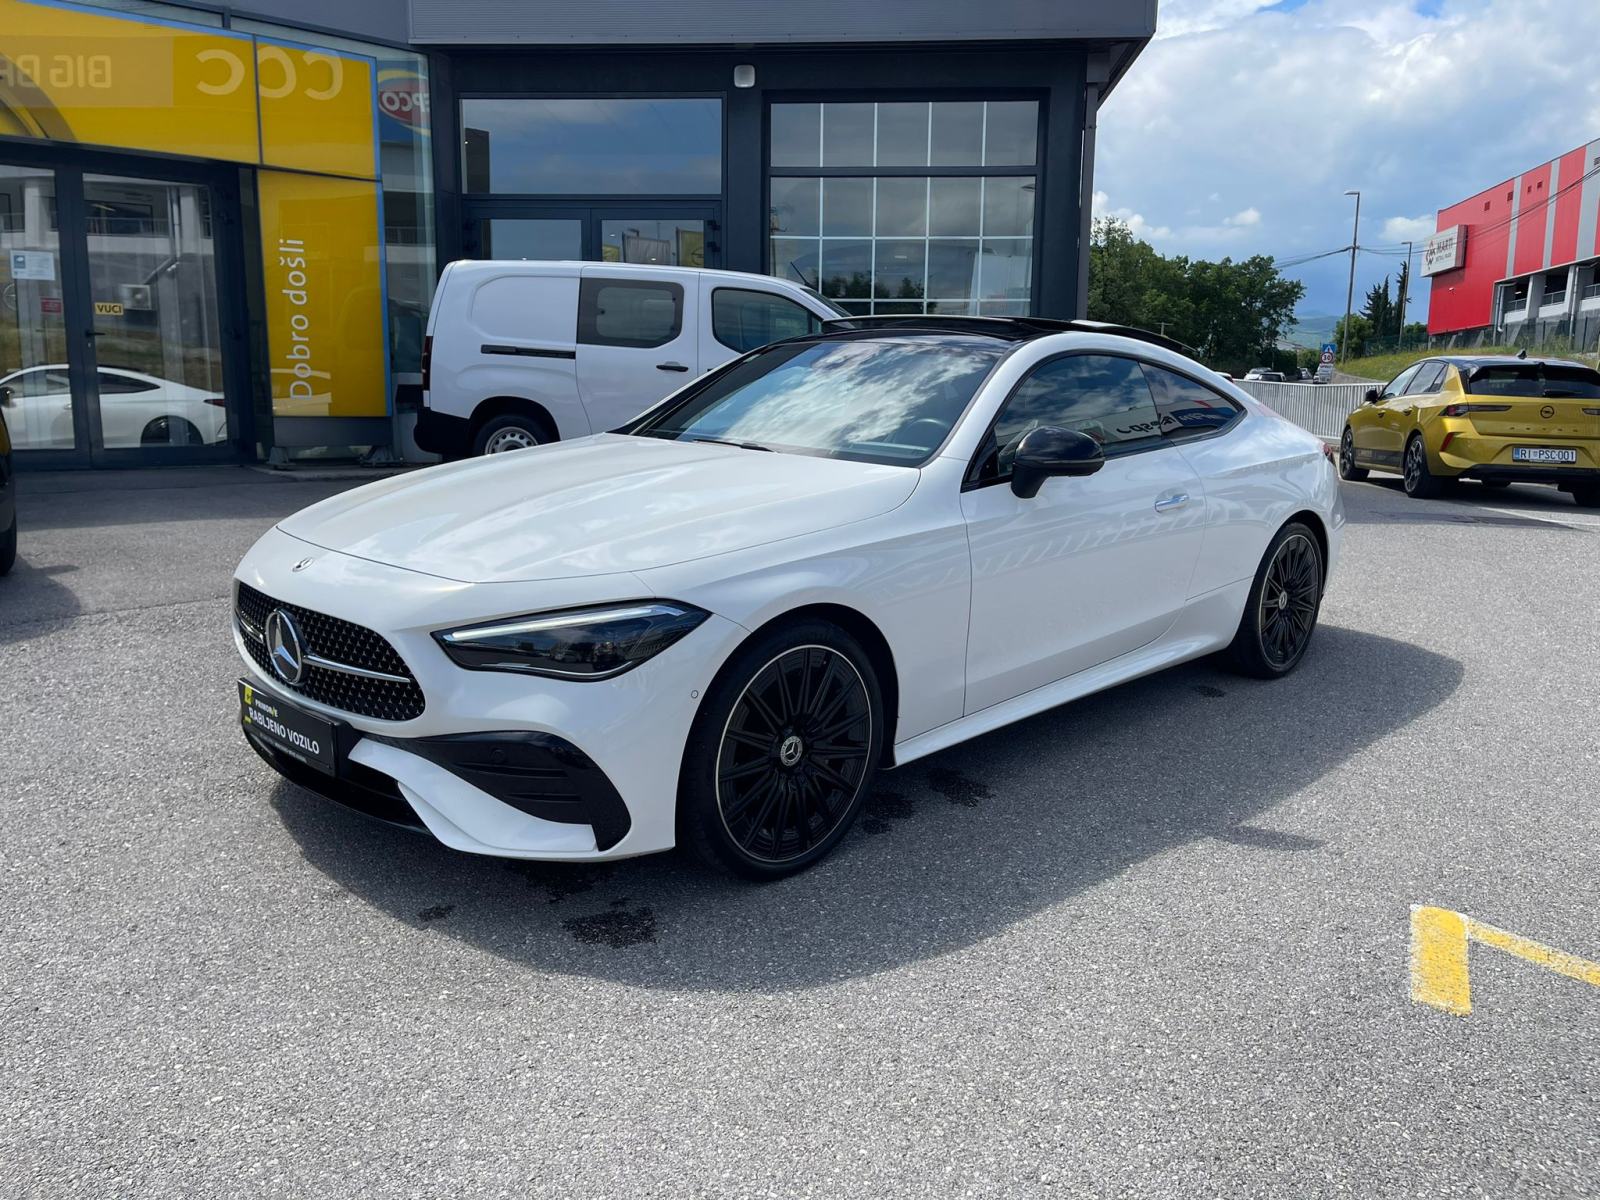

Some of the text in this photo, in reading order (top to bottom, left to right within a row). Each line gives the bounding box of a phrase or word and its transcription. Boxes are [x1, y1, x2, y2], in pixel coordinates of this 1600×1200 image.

[96, 304, 122, 314] VUCI
[279, 239, 312, 400] Dobro došli
[1520, 449, 1530, 459] RI
[248, 706, 286, 738] RABLJENO
[287, 728, 320, 755] VOZILO
